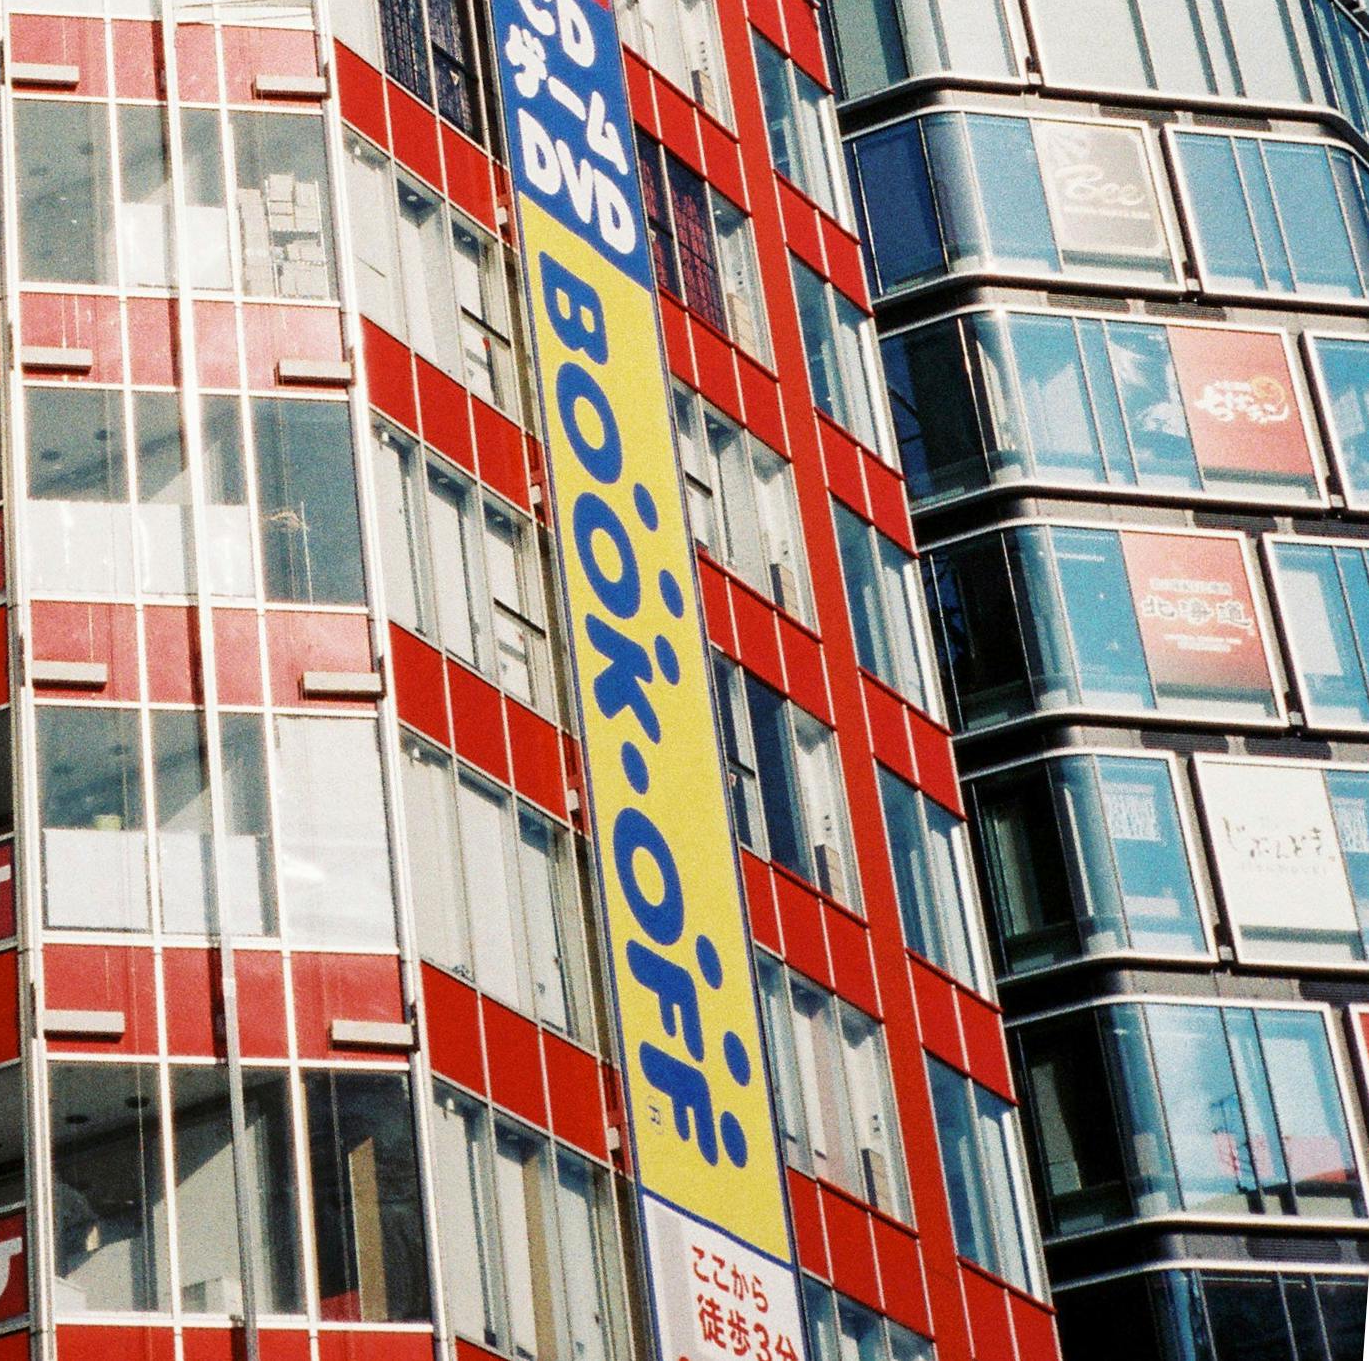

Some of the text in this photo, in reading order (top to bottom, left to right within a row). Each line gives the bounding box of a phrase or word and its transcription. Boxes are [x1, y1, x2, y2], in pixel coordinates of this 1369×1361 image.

[504, 22, 629, 176] ゲーム
[518, 106, 637, 255] DVD
[691, 1244, 769, 1314] ここから
